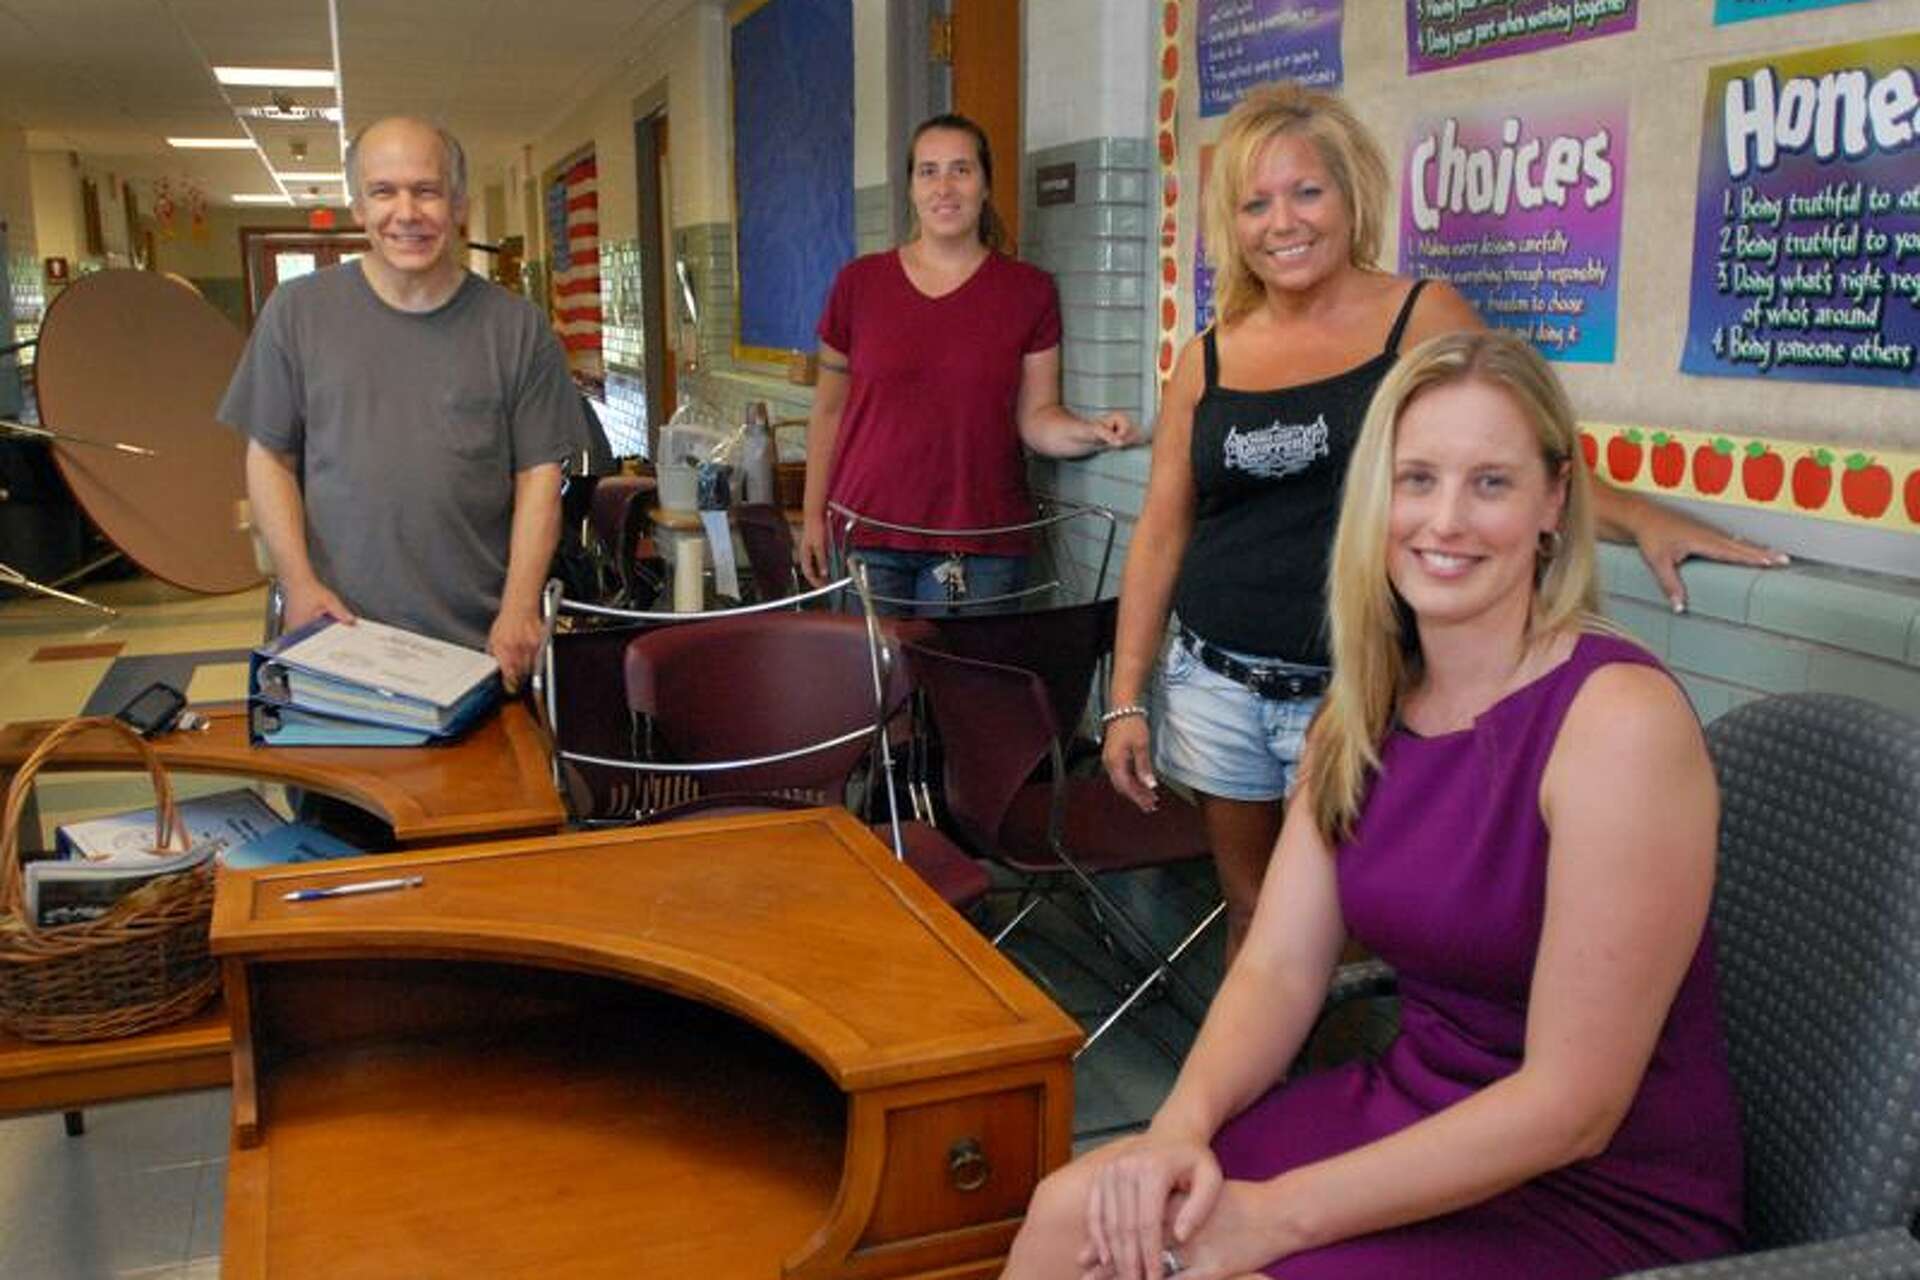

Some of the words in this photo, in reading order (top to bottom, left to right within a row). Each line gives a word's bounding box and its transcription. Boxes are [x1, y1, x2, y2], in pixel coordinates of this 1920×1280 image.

[1527, 1, 1572, 34] working
[1741, 185, 1782, 229] Being
[1788, 180, 1862, 218] truthful
[1869, 187, 1891, 212] to
[1517, 228, 1568, 256] carefully
[1736, 224, 1778, 268] Being
[1785, 221, 1859, 260] truthful
[1865, 228, 1888, 252] to
[1546, 253, 1609, 290] responsibly
[1733, 262, 1775, 303] Doing
[1780, 261, 1833, 295] what's
[1840, 260, 1884, 303] right
[1743, 297, 1762, 328] of
[1765, 296, 1810, 329] who's
[1814, 294, 1881, 327] around
[1729, 324, 1771, 369] Being
[1776, 339, 1846, 361] someone
[1851, 332, 1912, 367] others
